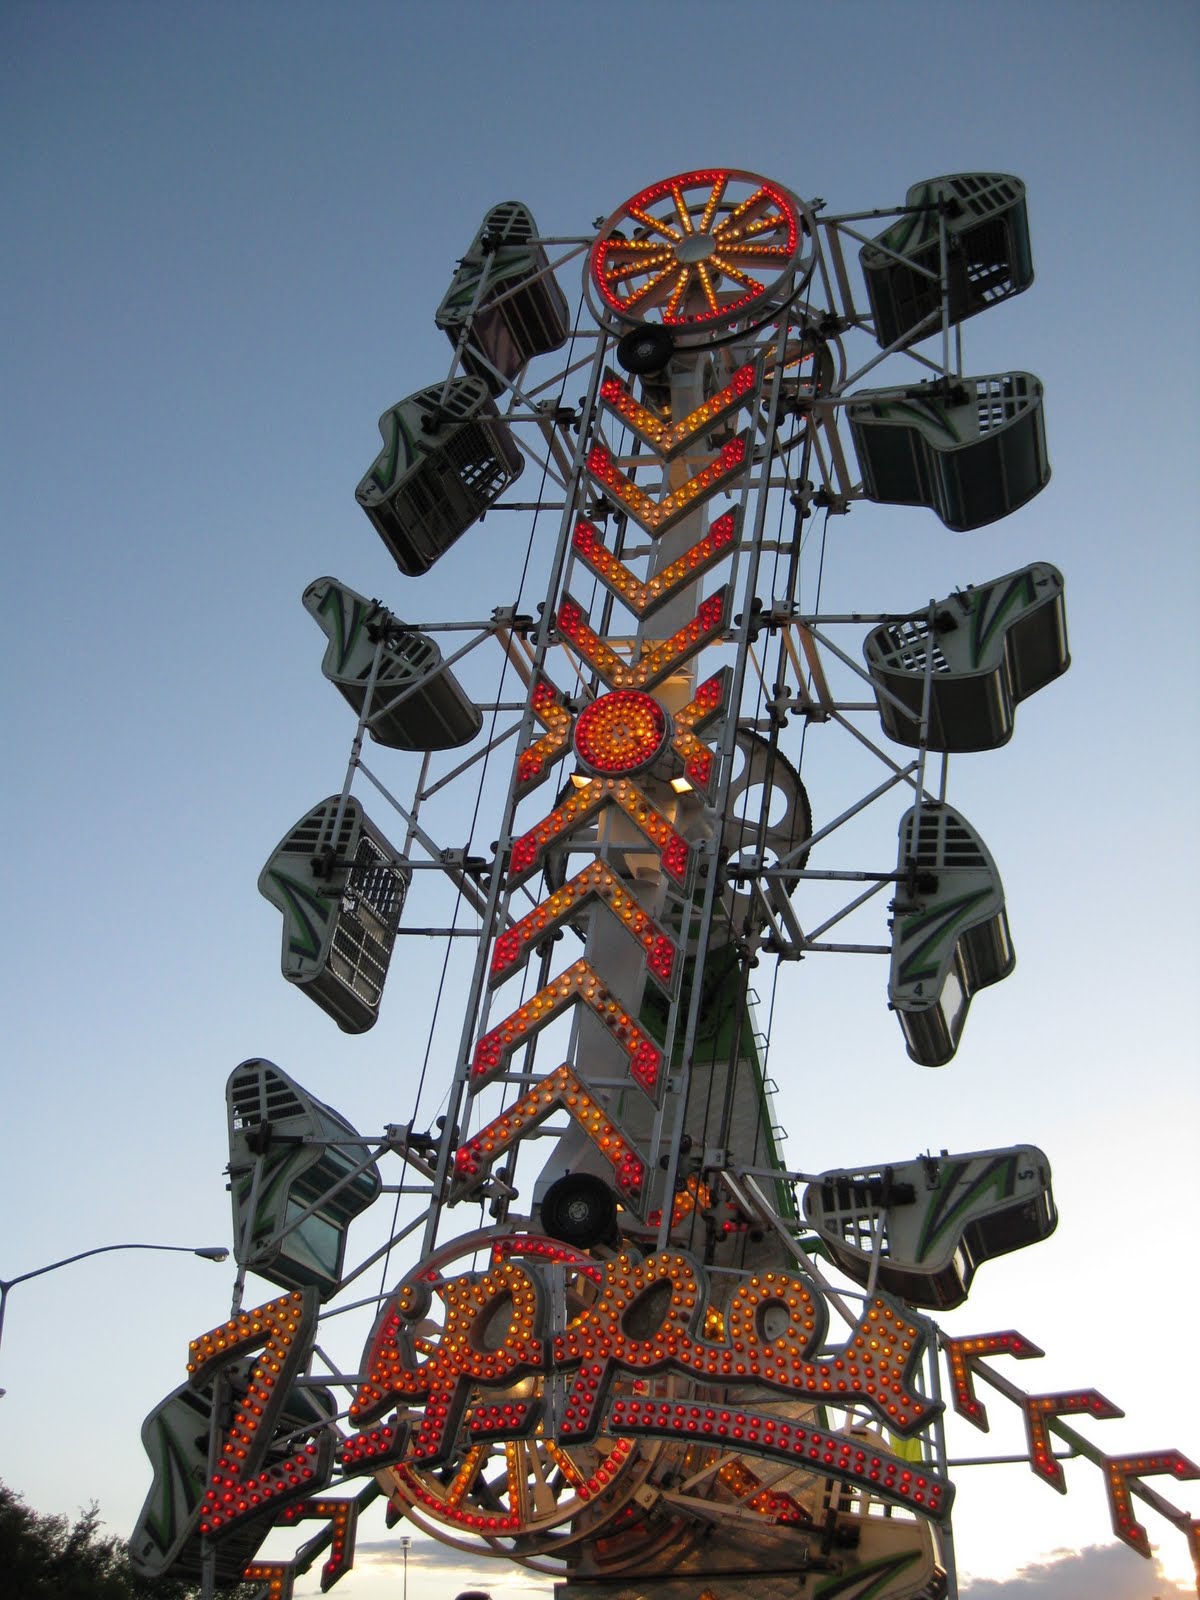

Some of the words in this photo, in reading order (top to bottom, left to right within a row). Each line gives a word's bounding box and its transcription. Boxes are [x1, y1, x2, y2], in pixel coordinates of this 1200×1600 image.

[914, 982, 923, 997] 4
[1018, 1169, 1034, 1181] 5
[142, 1541, 154, 1556] 6
